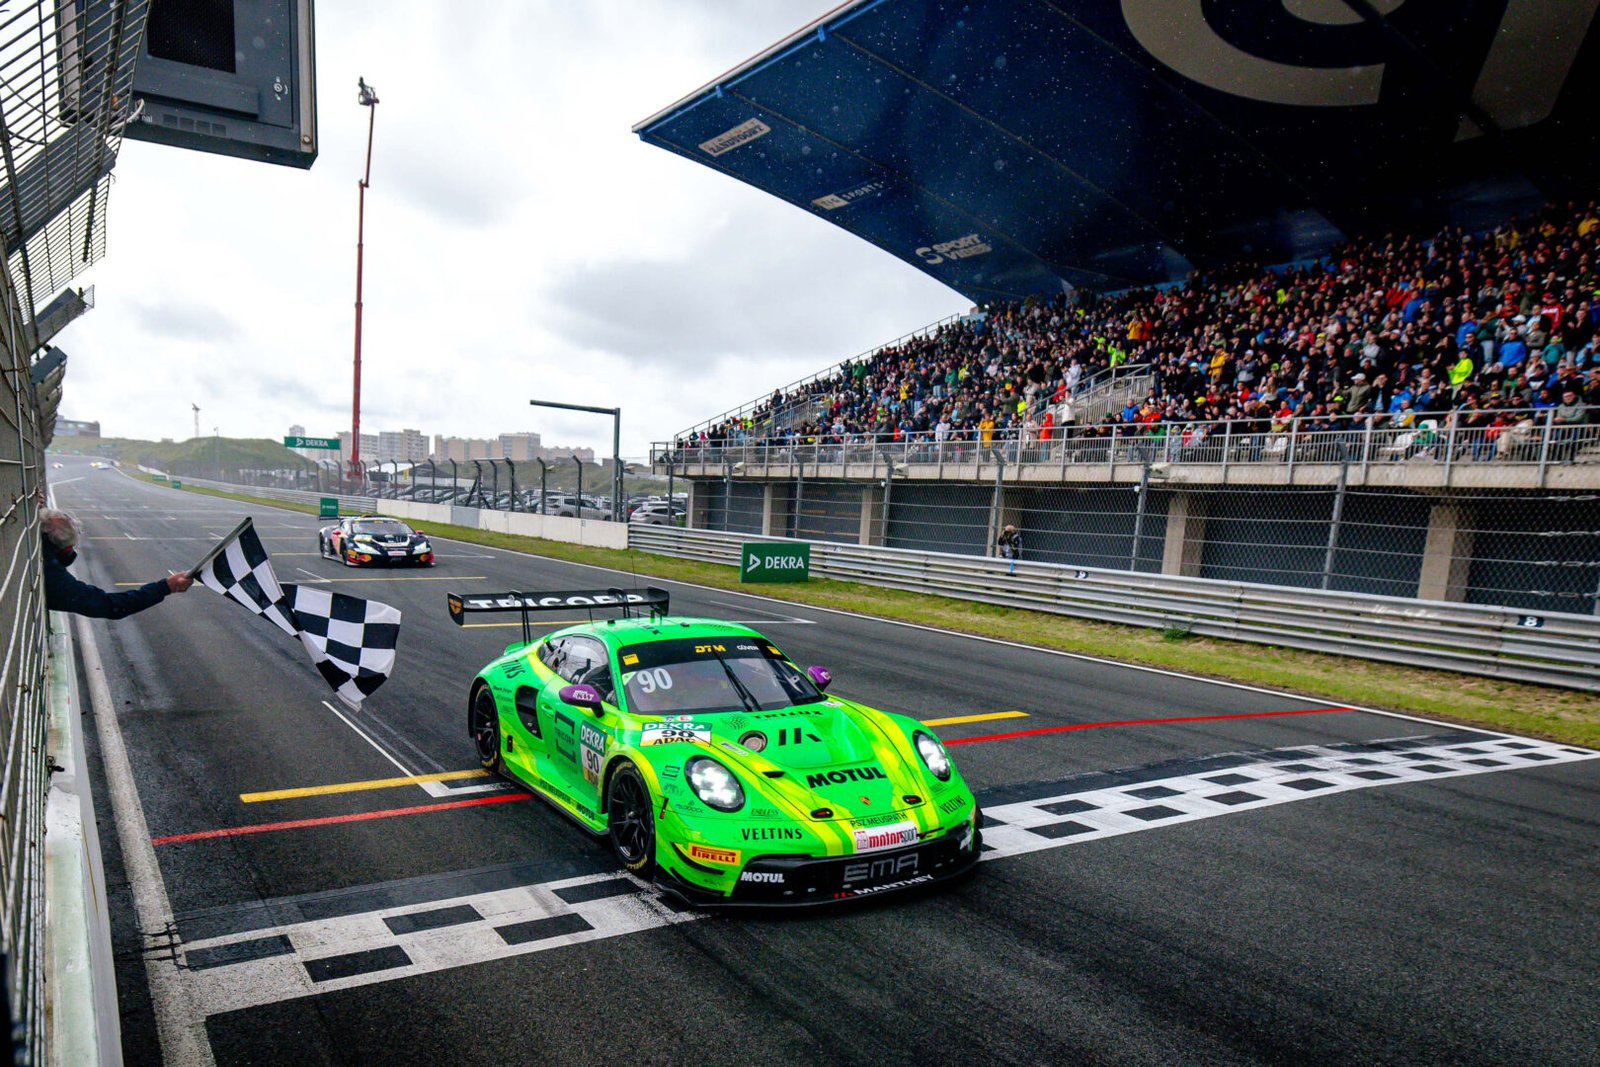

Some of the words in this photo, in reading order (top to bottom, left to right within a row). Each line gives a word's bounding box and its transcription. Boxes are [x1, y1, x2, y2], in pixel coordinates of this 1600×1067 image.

[932, 233, 981, 253] SPORT
[305, 439, 329, 447] DEKRA
[765, 556, 805, 569] DEKRA
[1523, 616, 1538, 627] 8
[695, 644, 727, 654] DTM
[636, 667, 674, 694] 90
[643, 722, 706, 730] DEKRA
[660, 730, 696, 738] 90
[580, 724, 606, 753] DEKRA
[652, 736, 697, 746] ADAC
[586, 749, 601, 774] 90
[805, 766, 888, 789] MOTUL
[939, 795, 966, 815] VELTINS
[741, 827, 803, 841] VELTINS
[691, 845, 737, 863] PIRELLI
[843, 852, 920, 883] EMA
[740, 871, 785, 884] MOTUL
[853, 873, 935, 897] MANTHEY
